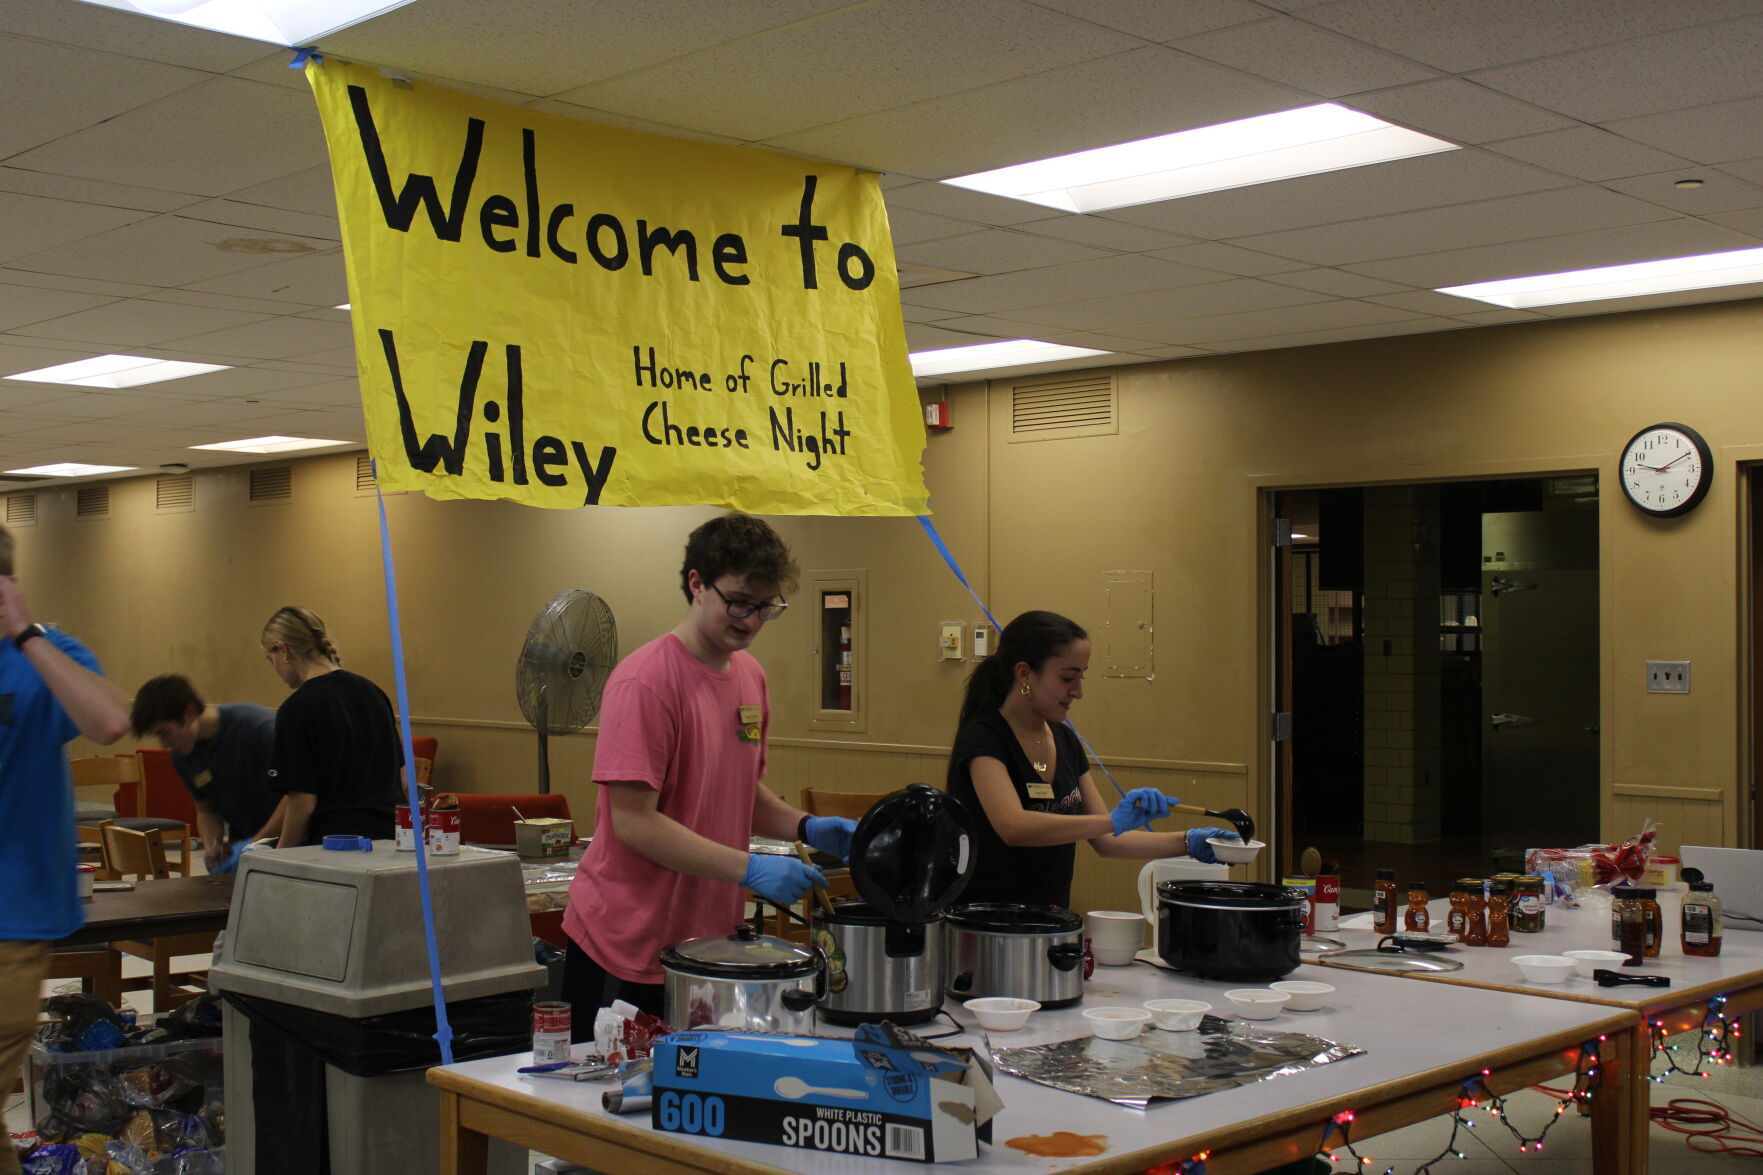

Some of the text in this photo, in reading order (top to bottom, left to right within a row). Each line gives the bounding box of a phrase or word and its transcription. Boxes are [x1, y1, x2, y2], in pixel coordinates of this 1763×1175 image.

[348, 85, 875, 290] Welcome to
[634, 345, 849, 398] Home of Grilled
[378, 329, 617, 506] Wiley
[641, 401, 851, 470] Cheese Night
[1644, 440, 1653, 450] 11
[1657, 435, 1668, 445] 12
[1630, 466, 1636, 475] 9
[1634, 452, 1645, 462] 10
[1688, 464, 1695, 473] 3
[660, 1090, 725, 1137] 600
[816, 1107, 882, 1124] WHITE PLASTIC
[782, 1116, 882, 1156] SPOONS
